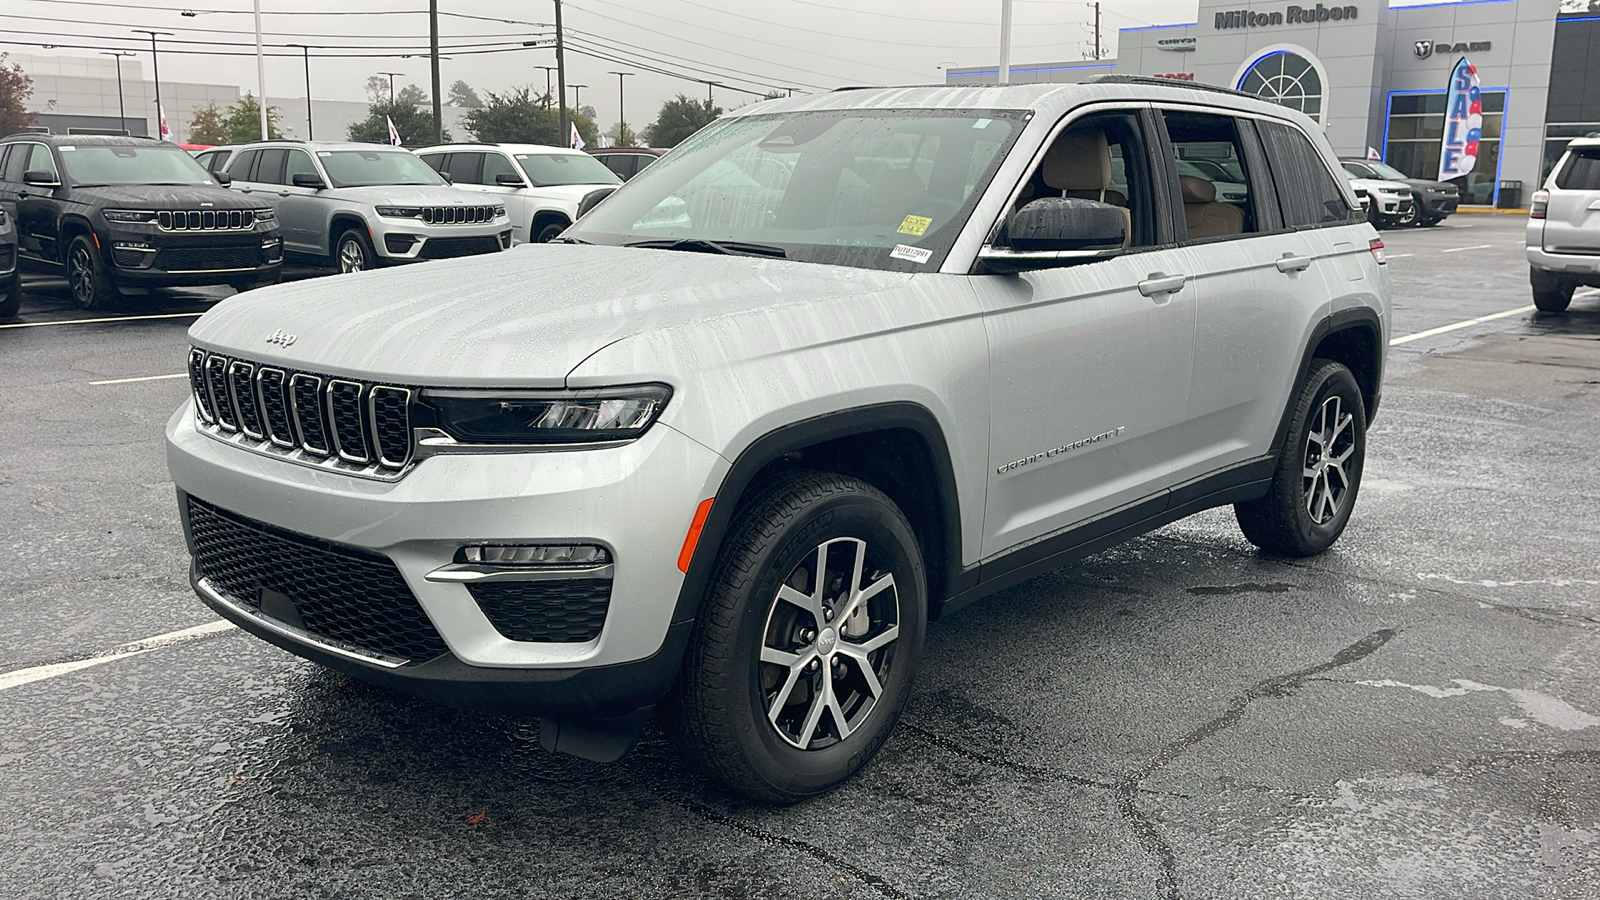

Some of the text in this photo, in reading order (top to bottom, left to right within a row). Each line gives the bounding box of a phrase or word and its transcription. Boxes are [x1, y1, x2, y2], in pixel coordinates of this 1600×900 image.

[1214, 3, 1358, 30] Milton Ruben
[1435, 41, 1491, 54] RAM
[1442, 66, 1472, 174] SALE
[265, 328, 299, 349] Jeep
[997, 430, 1115, 474] GRAND CHEROKEE
